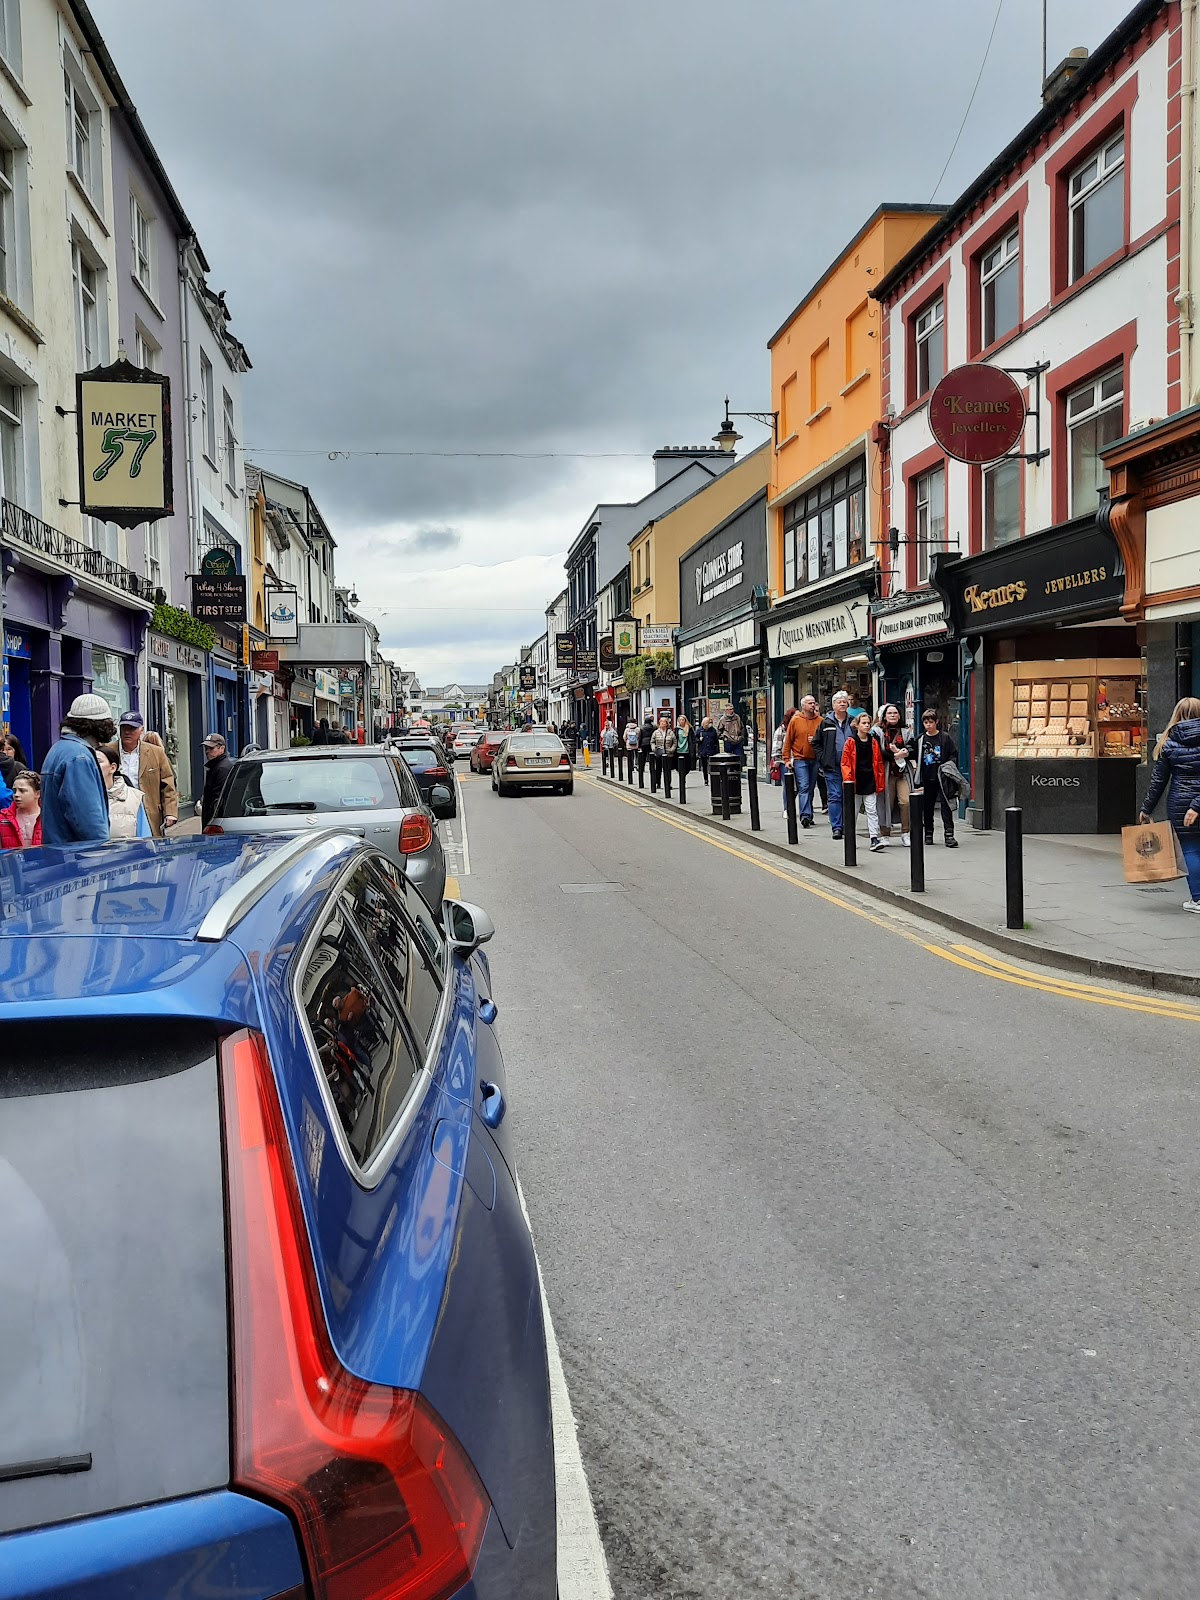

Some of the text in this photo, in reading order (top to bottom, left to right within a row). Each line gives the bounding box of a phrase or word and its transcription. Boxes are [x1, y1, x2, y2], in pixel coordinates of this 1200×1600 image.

[943, 395, 1010, 414] Keanes
[91, 411, 157, 428] MARKET
[950, 421, 1007, 436] Jewellers
[93, 427, 157, 481] 57
[702, 540, 743, 588] GUINNESS STORE
[216, 583, 222, 591] 4
[964, 566, 1107, 613] Keanes JEWELLERS
[224, 605, 243, 613] STEP
[899, 619, 913, 631] IRISH
[914, 615, 927, 627] GIFT
[781, 615, 847, 649] QUILLS MENSWEAR
[7, 634, 22, 650] SHOP
[1031, 774, 1080, 787] Keanes
